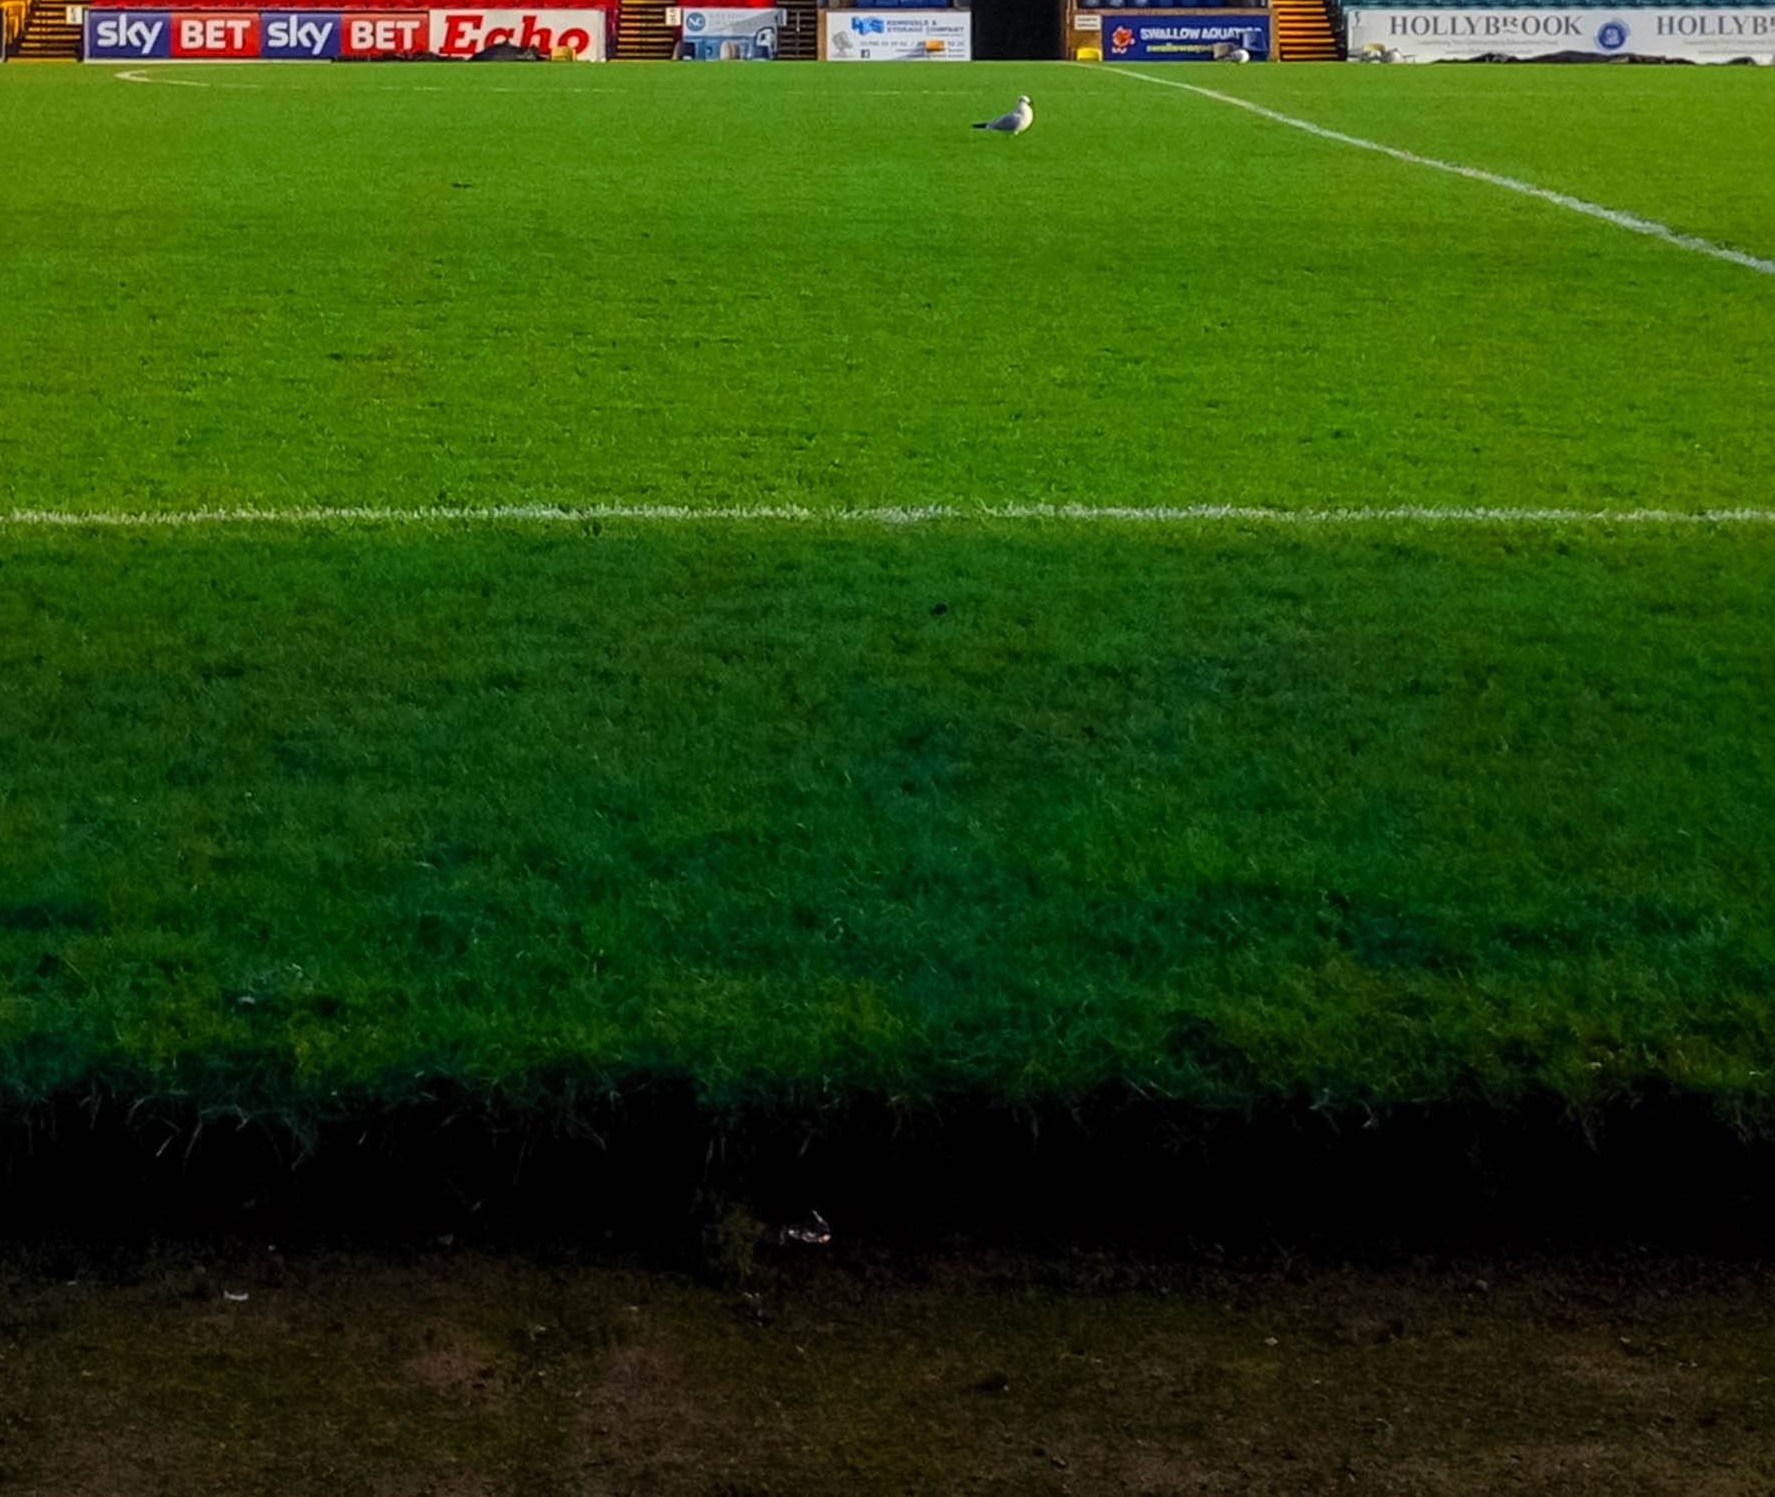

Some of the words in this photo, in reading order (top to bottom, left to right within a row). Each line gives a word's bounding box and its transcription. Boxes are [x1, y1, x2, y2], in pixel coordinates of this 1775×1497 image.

[96, 13, 162, 55] sky
[181, 19, 251, 50] BET
[267, 14, 333, 55] sky
[350, 20, 420, 50] BET
[438, 14, 591, 57] Echo
[1139, 27, 1200, 40] SWALLOW
[1202, 26, 1262, 40] AQUAT
[1390, 14, 1583, 37] HOLLYBROOK
